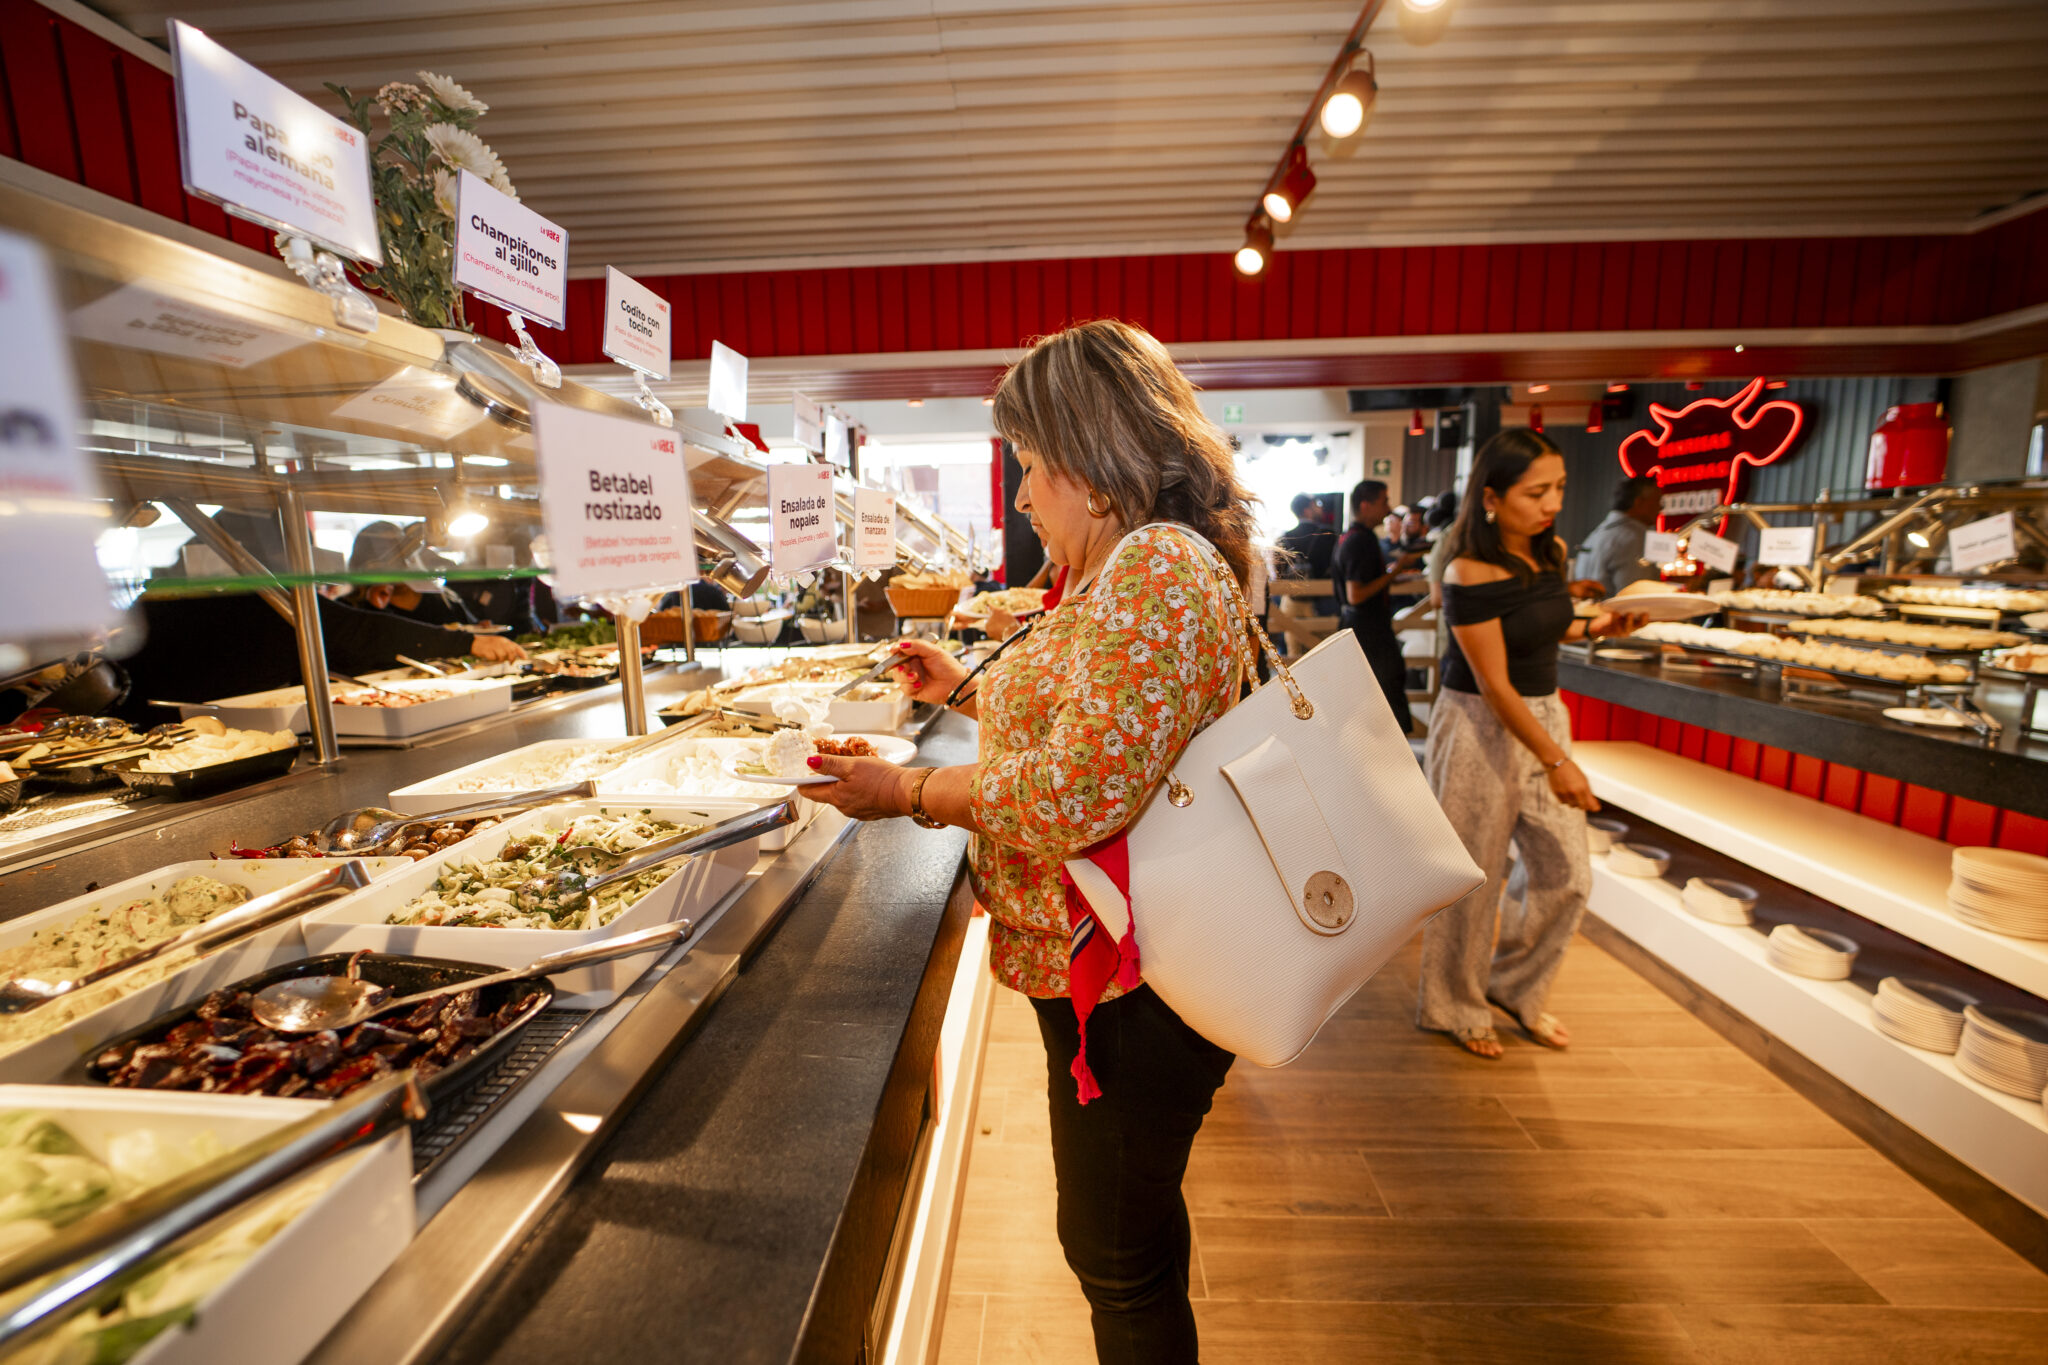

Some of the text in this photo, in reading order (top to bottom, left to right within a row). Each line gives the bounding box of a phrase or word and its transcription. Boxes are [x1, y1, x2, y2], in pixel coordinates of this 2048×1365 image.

[232, 99, 289, 147] Papa
[244, 132, 335, 191] alemana
[471, 214, 557, 270] Champiñones
[495, 246, 539, 277] al ajillo
[506, 273, 515, 283] ajo
[521, 279, 535, 291] chile
[536, 287, 543, 295] de
[620, 299, 646, 322] Codito
[647, 316, 660, 330] con
[629, 317, 653, 338] tocino
[589, 469, 653, 495] Betabel
[585, 497, 662, 521] rostizado
[781, 495, 826, 514] Ensalada de
[790, 512, 820, 531] nopales
[861, 512, 890, 524] Ensalada de
[659, 535, 672, 545] con
[864, 526, 887, 536] manzana
